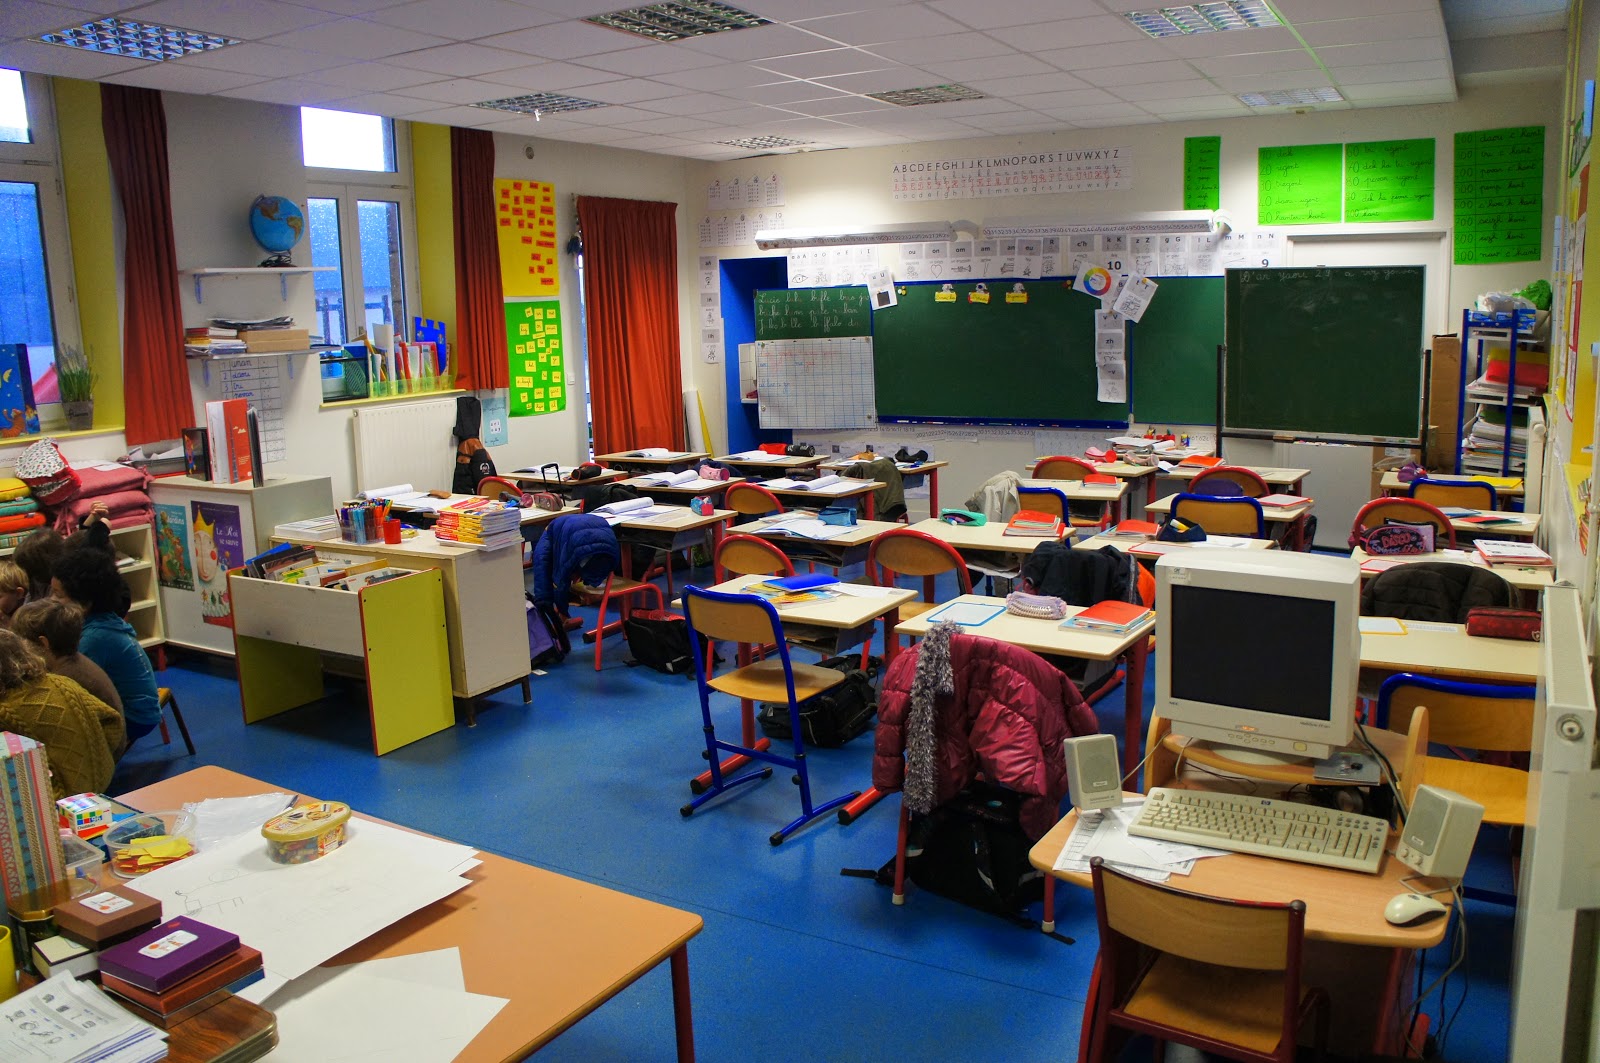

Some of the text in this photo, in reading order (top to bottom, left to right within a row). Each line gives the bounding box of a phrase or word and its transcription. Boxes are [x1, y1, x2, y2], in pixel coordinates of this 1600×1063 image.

[1259, 212, 1272, 223] 50
[1107, 261, 1121, 270] 10
[1262, 259, 1269, 267] 9
